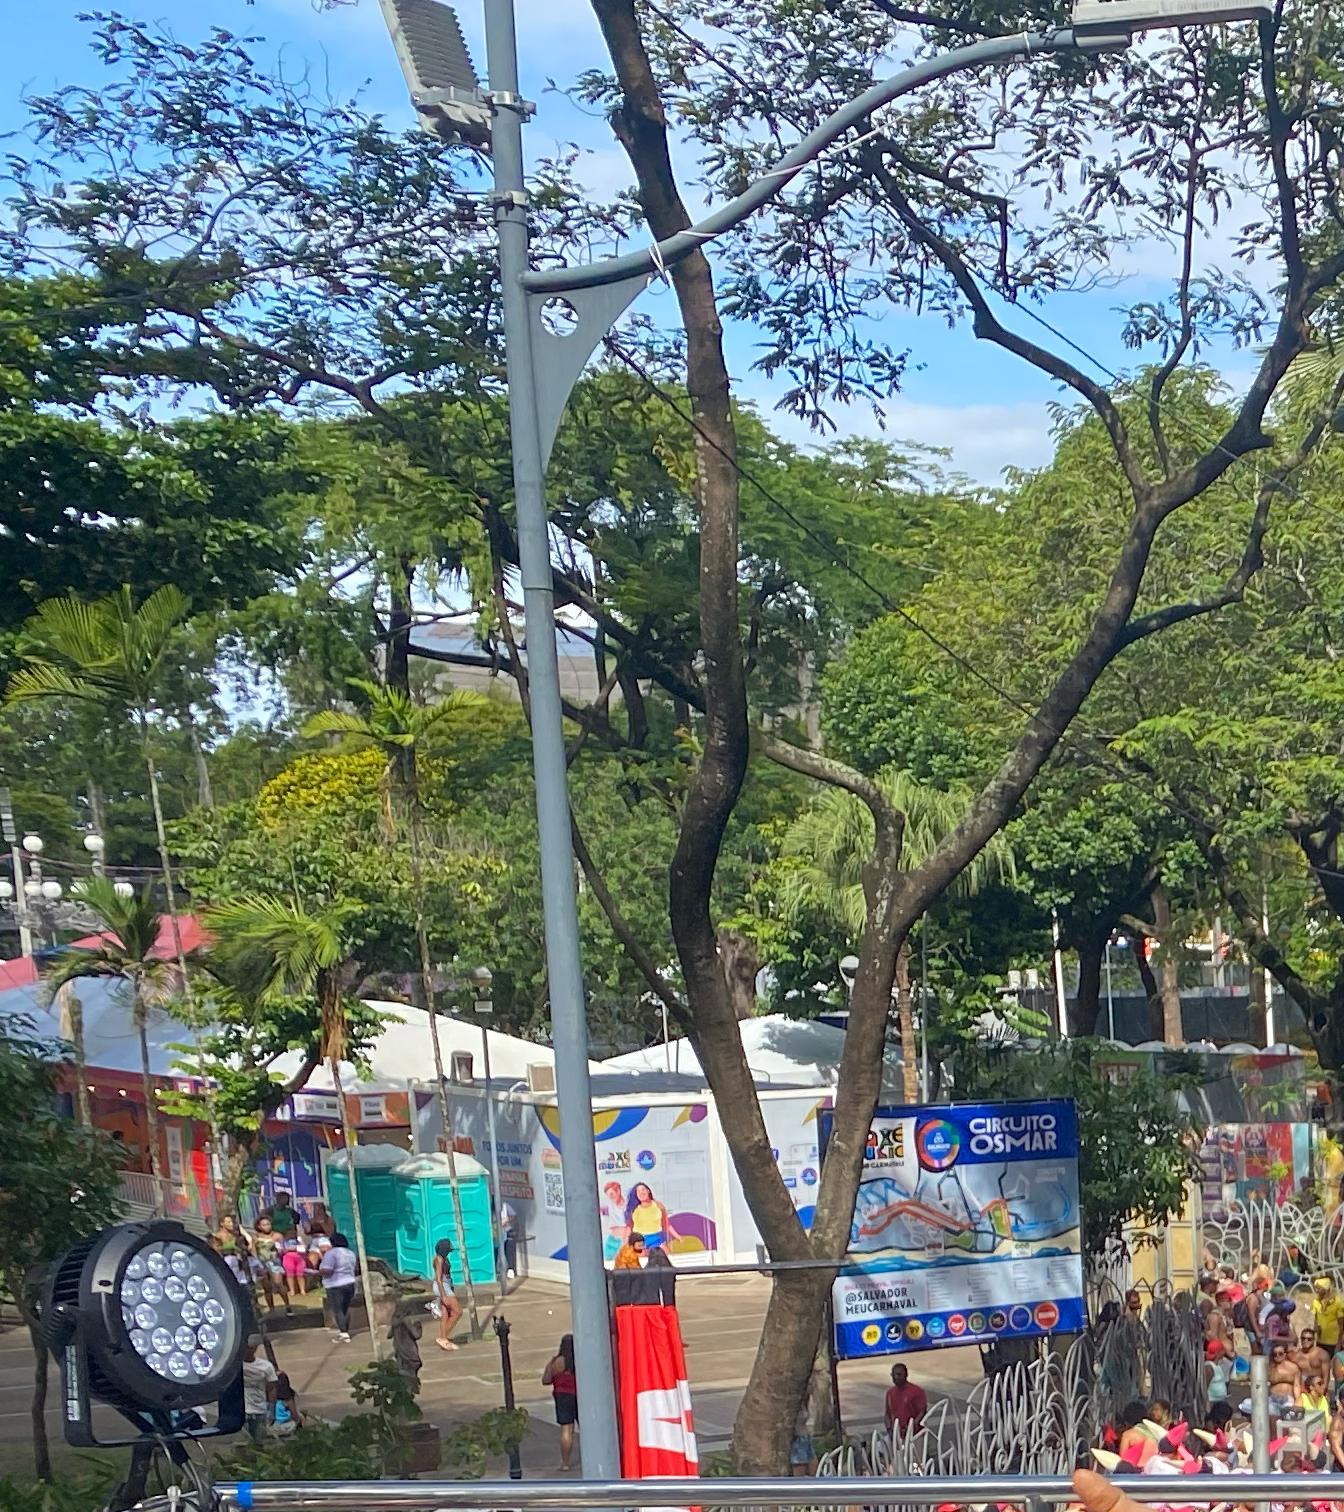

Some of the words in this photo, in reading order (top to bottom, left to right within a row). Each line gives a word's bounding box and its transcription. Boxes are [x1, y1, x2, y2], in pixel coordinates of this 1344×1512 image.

[969, 1114, 1056, 1134] CIRCUITO
[970, 1131, 1057, 1155] OSMAR
[845, 1287, 908, 1305] @SALVADOR
[845, 1298, 919, 1315] MEUCARNAVAL
